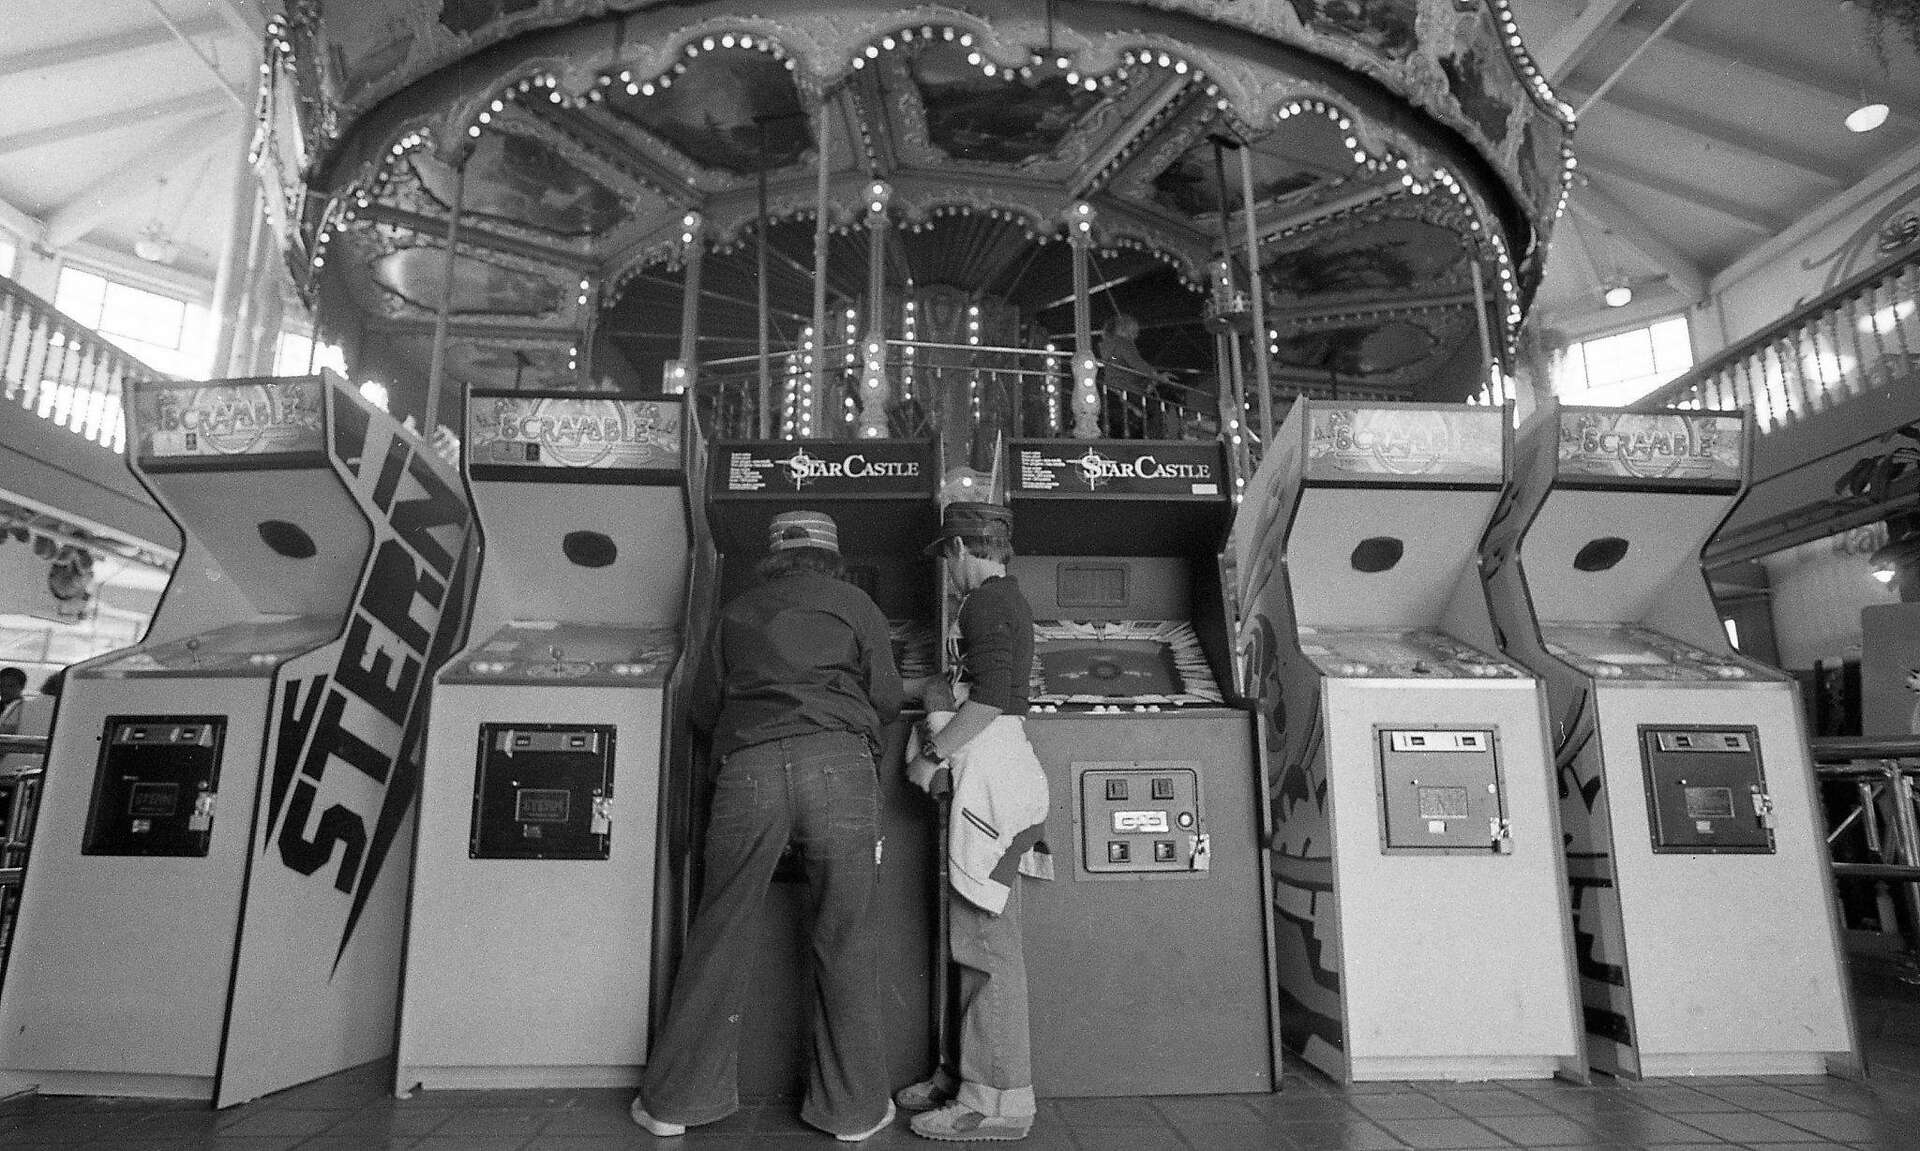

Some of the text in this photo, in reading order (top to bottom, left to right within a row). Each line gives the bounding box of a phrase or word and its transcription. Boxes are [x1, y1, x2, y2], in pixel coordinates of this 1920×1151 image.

[501, 414, 650, 445] SCRAMBLE
[1583, 426, 1713, 459] SCRAMBLE
[278, 452, 471, 895] STERN
